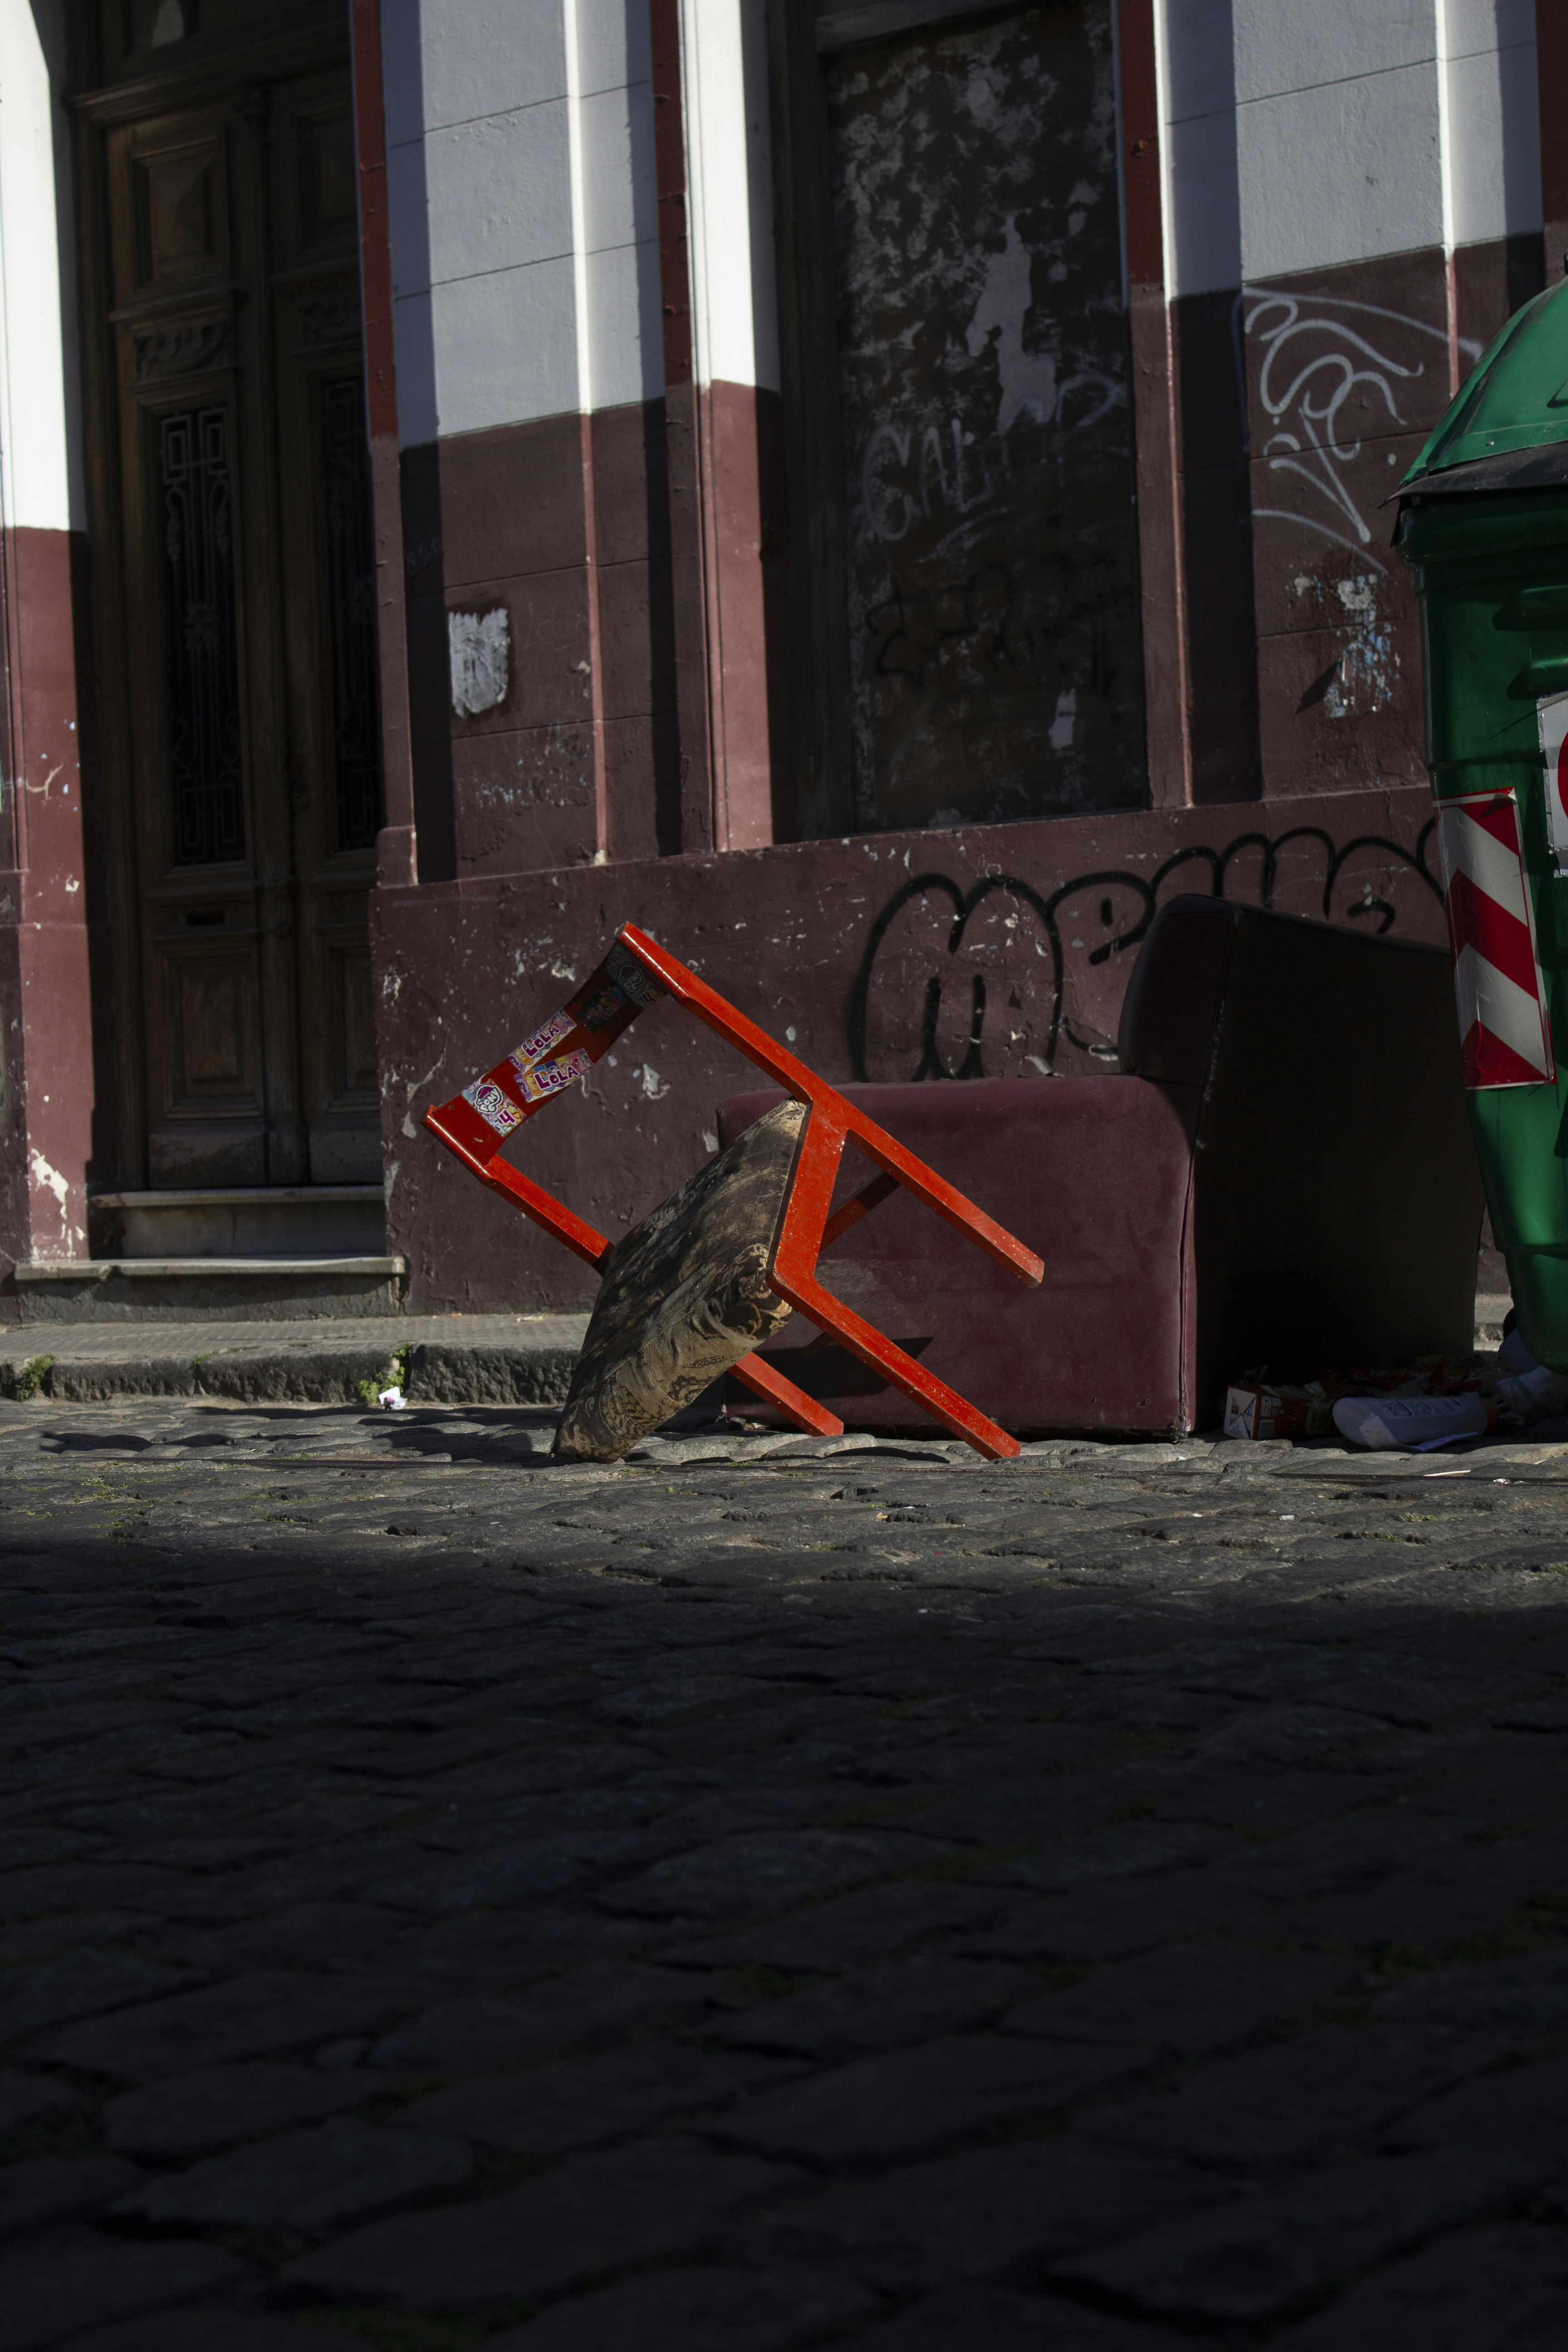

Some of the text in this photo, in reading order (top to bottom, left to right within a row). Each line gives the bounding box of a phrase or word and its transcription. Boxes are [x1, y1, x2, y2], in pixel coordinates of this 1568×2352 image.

[609, 951, 625, 966] OLA
[623, 969, 642, 990] PONY
[641, 990, 657, 1004] 4
[600, 1003, 620, 1019] LOLA
[523, 1027, 559, 1057] LOLA
[534, 1066, 579, 1089] LOLA
[480, 1088, 500, 1112] PONY
[499, 1109, 516, 1123] 4
